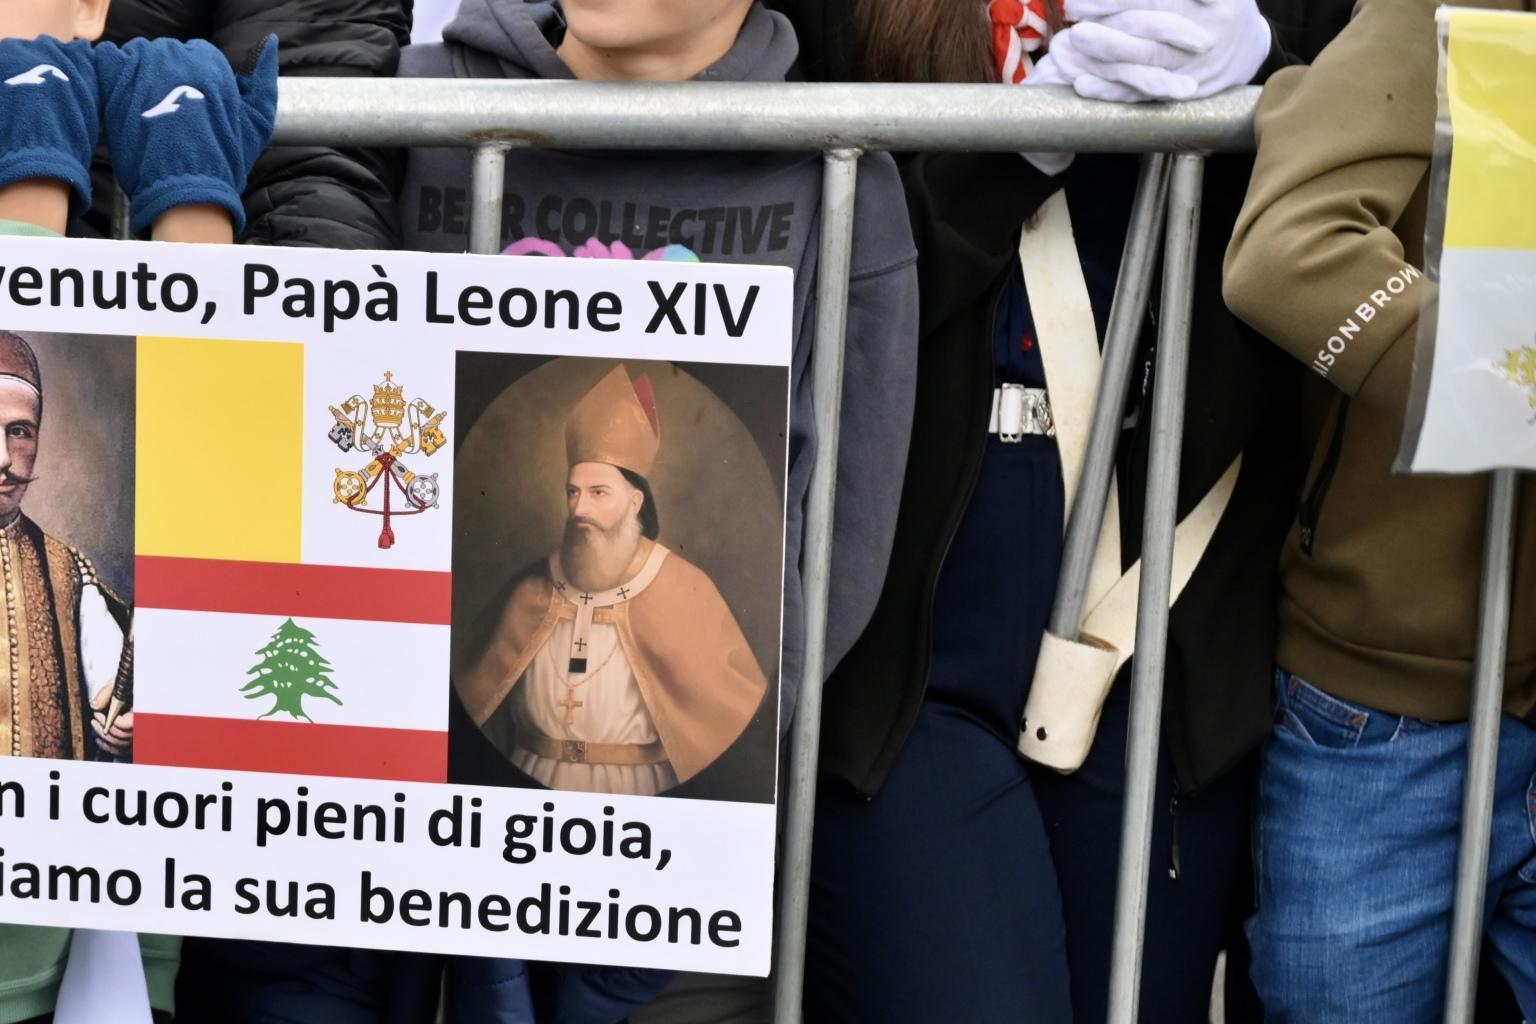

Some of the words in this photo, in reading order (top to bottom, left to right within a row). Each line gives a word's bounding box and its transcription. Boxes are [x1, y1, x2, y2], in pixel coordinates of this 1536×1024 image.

[418, 186, 525, 242] BER
[536, 198, 795, 256] COLLECTIVE
[243, 263, 399, 333] Papà
[425, 270, 624, 333] Leone
[644, 280, 761, 338] XIV
[1355, 264, 1423, 322] BROW
[49, 770, 61, 821] i
[82, 781, 233, 832] cuori
[256, 786, 406, 848] pieni
[428, 794, 483, 849] di
[502, 801, 672, 871] gioia,
[164, 857, 212, 912] la
[234, 877, 336, 920] sua
[360, 870, 742, 948] benedizione
